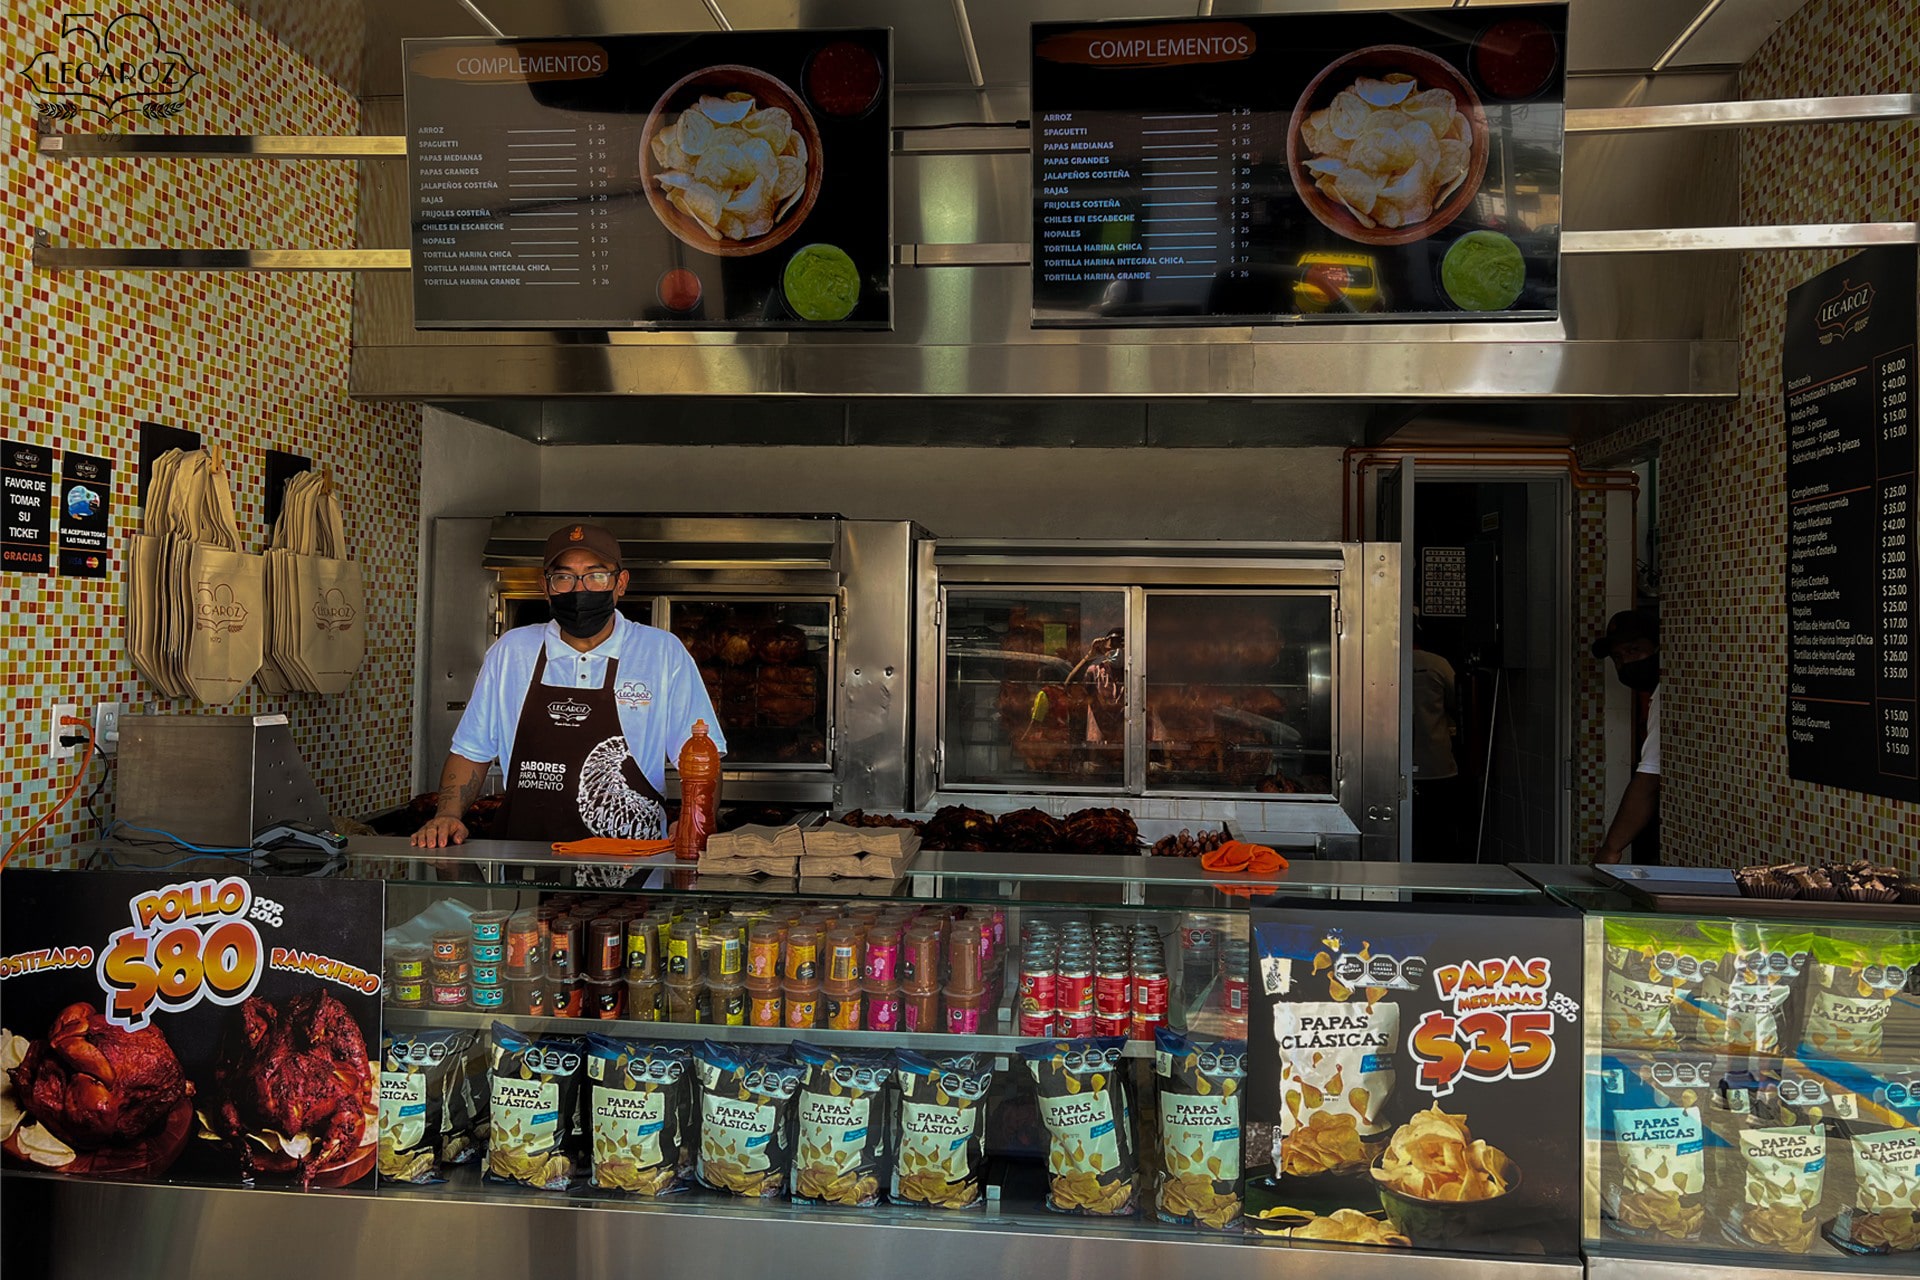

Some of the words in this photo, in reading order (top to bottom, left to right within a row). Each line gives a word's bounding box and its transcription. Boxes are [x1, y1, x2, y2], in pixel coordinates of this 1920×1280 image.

[1088, 36, 1249, 59] COMPLEMENTOS
[456, 54, 602, 75] COMPLEMENTOS
[1043, 114, 1072, 122] ARROZ
[1044, 128, 1088, 136] SPAGUETTI
[1044, 143, 1069, 151] PAPAS
[1071, 142, 1114, 150] MEDIANAS
[1071, 156, 1110, 164] GRANDES
[1043, 171, 1090, 181] JALAPEÑOS
[1092, 169, 1130, 179] COSTEÑA
[420, 181, 462, 190] JALAPEÑOS
[464, 180, 498, 189] COSTEÑA
[1044, 187, 1069, 196] RAJAS
[421, 196, 443, 204] RAJAS
[1044, 201, 1081, 210] FRIJOLES
[1082, 199, 1121, 208] COSTEÑA
[421, 210, 455, 218] FRIJOLES
[456, 208, 491, 217] COSTEÑA
[1074, 215, 1085, 223] EN
[1087, 214, 1135, 223] ESCABECHE
[449, 223, 460, 231] EN
[461, 223, 505, 231] ESCABECHE
[1044, 230, 1081, 238] NOPALES
[422, 237, 456, 245] NOPALES
[1084, 244, 1115, 252] HARINA
[1117, 243, 1143, 251] CHICA
[489, 250, 512, 258] CHICA
[489, 264, 526, 272] INTEGRAL
[527, 264, 551, 272] CHICA
[1044, 259, 1081, 267] TORTILLA
[1117, 257, 1157, 265] INTEGRAL
[1159, 256, 1184, 264] CHICA
[460, 278, 488, 286] HARINA
[490, 278, 521, 286] GRANDE
[1084, 273, 1115, 281] HARINA
[1117, 272, 1151, 280] GRANDE
[1822, 288, 1868, 322] LECAROZ
[5, 476, 33, 490] FAVOR
[34, 481, 46, 492] DE
[10, 494, 40, 507] TOMAR
[18, 511, 31, 522] SU
[9, 526, 39, 539] TICKET
[68, 528, 90, 537] ACEPTAN
[3, 551, 43, 562] GRACIAS
[520, 761, 567, 774] SABORES
[519, 772, 537, 780] PARA
[539, 772, 564, 782] TODO
[517, 780, 564, 791] MOMENTO
[135, 881, 247, 927] POLLO
[253, 896, 285, 916] POR
[249, 907, 284, 928] SOLO
[104, 921, 259, 1025] $80
[271, 948, 379, 993] RANCHERO
[1436, 960, 1548, 996] PAPAS
[1622, 985, 1673, 1004] PAPAS
[1457, 991, 1544, 1013] MEDIANAS
[1552, 992, 1581, 1012] POR
[1547, 1001, 1577, 1023] SOLO
[1300, 1015, 1368, 1030] PAPAS
[1281, 1031, 1389, 1050] CLÁSICAS
[1414, 1012, 1554, 1091] $35
[501, 1086, 540, 1099] PAPAS
[491, 1095, 552, 1110] CLÁSICAS
[607, 1097, 646, 1109] PAPAS
[812, 1102, 852, 1115] PAPAS
[596, 1104, 657, 1120] CLÁSICAS
[715, 1106, 756, 1121] PAPAS
[1050, 1102, 1091, 1117] PAPAS
[1176, 1104, 1218, 1115] PAPAS
[705, 1113, 767, 1133] CLÁSICAS
[801, 1109, 863, 1126] CLÁSICAS
[917, 1112, 961, 1124] PAPAS
[1046, 1111, 1106, 1127] CLÁSICAS
[1166, 1113, 1232, 1126] CLÁSICAS
[1634, 1117, 1679, 1129] PAPAS
[906, 1119, 969, 1135] CLÁSICAS
[1621, 1127, 1695, 1142] CLÁSICAS
[1760, 1135, 1807, 1149] PAPAS
[1870, 1137, 1917, 1153] PAPAS
